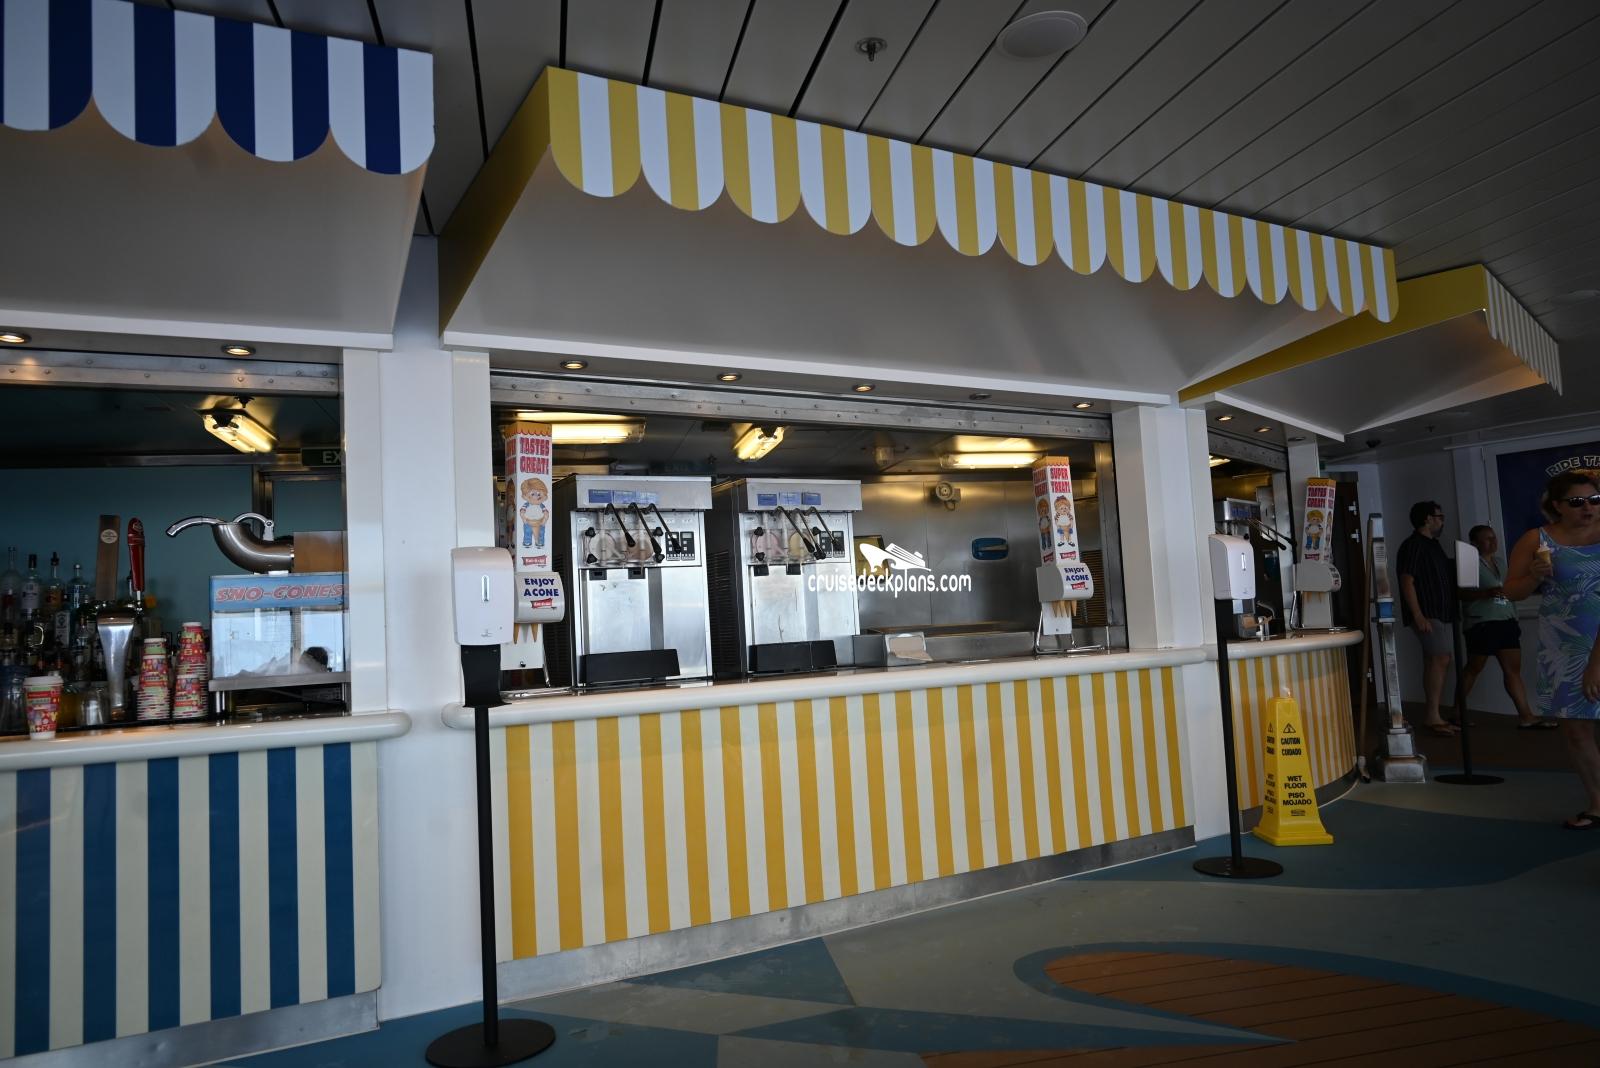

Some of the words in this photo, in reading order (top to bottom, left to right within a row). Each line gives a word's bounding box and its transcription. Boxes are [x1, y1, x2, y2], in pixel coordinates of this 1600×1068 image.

[520, 437, 550, 456] TASTES
[322, 450, 341, 464] EX
[520, 456, 550, 475] GREAT!
[1545, 456, 1581, 478] RIDE
[1050, 468, 1068, 480] SUPER
[524, 578, 555, 587] ENJOY
[216, 584, 343, 603] SNO-CONES
[523, 588, 532, 597] A
[532, 588, 559, 597] CONE
